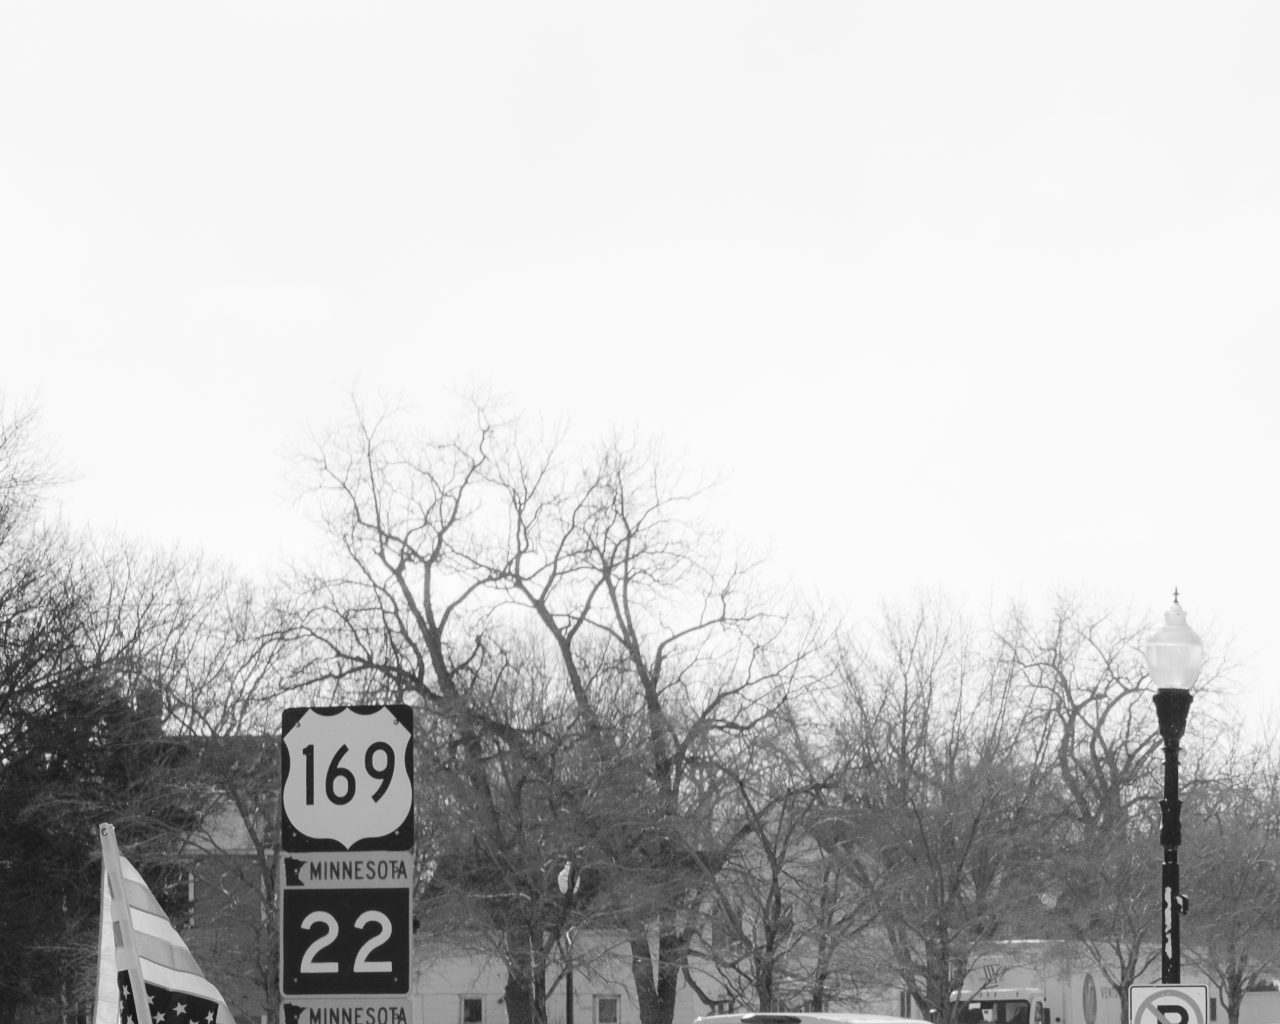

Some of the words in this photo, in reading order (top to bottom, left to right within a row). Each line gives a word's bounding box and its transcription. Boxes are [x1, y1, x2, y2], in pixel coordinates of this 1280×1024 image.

[302, 741, 395, 806] 169
[309, 860, 408, 881] MINNESOTA
[300, 910, 393, 974] 22
